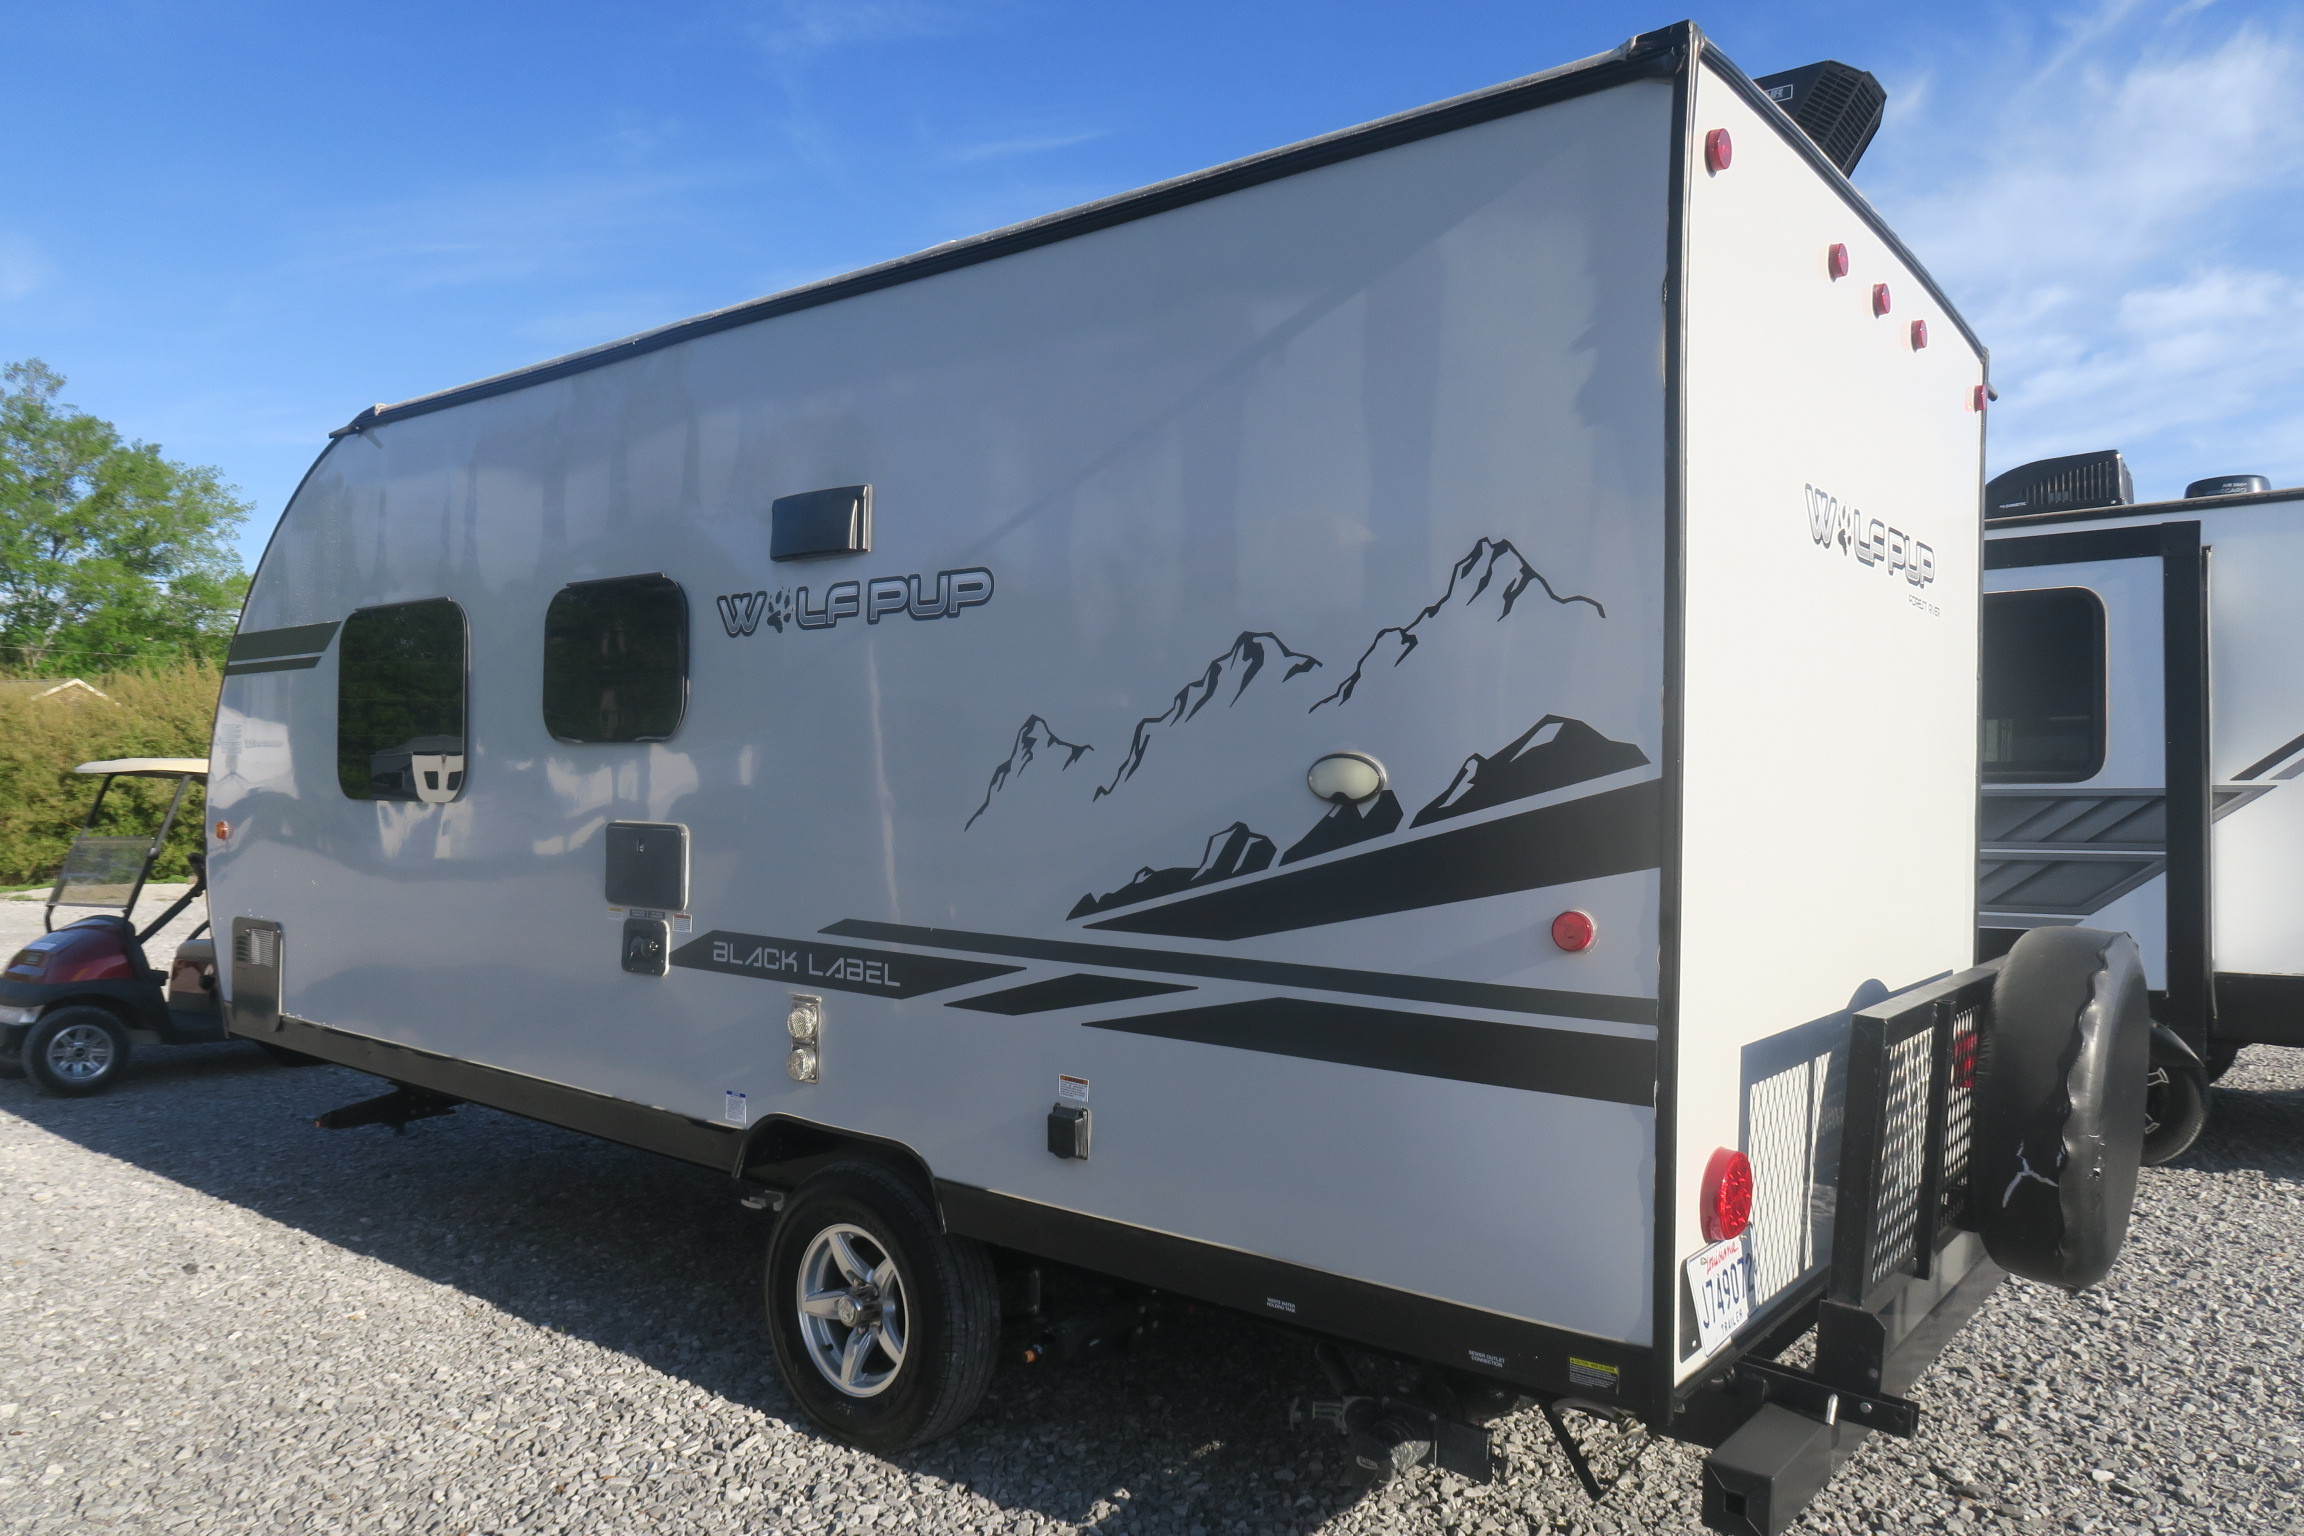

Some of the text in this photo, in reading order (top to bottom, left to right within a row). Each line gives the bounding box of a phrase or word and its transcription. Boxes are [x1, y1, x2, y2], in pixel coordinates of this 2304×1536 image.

[1888, 526, 1935, 589] PUP
[867, 566, 995, 625] PUP
[713, 940, 901, 987] BLACK LABEL
[1701, 1252, 1755, 1329] J749072
[1720, 1307, 1743, 1335] TRAILER
[1471, 1355, 1503, 1368] CONNECTION
[1486, 1354, 1505, 1363] OUTLET
